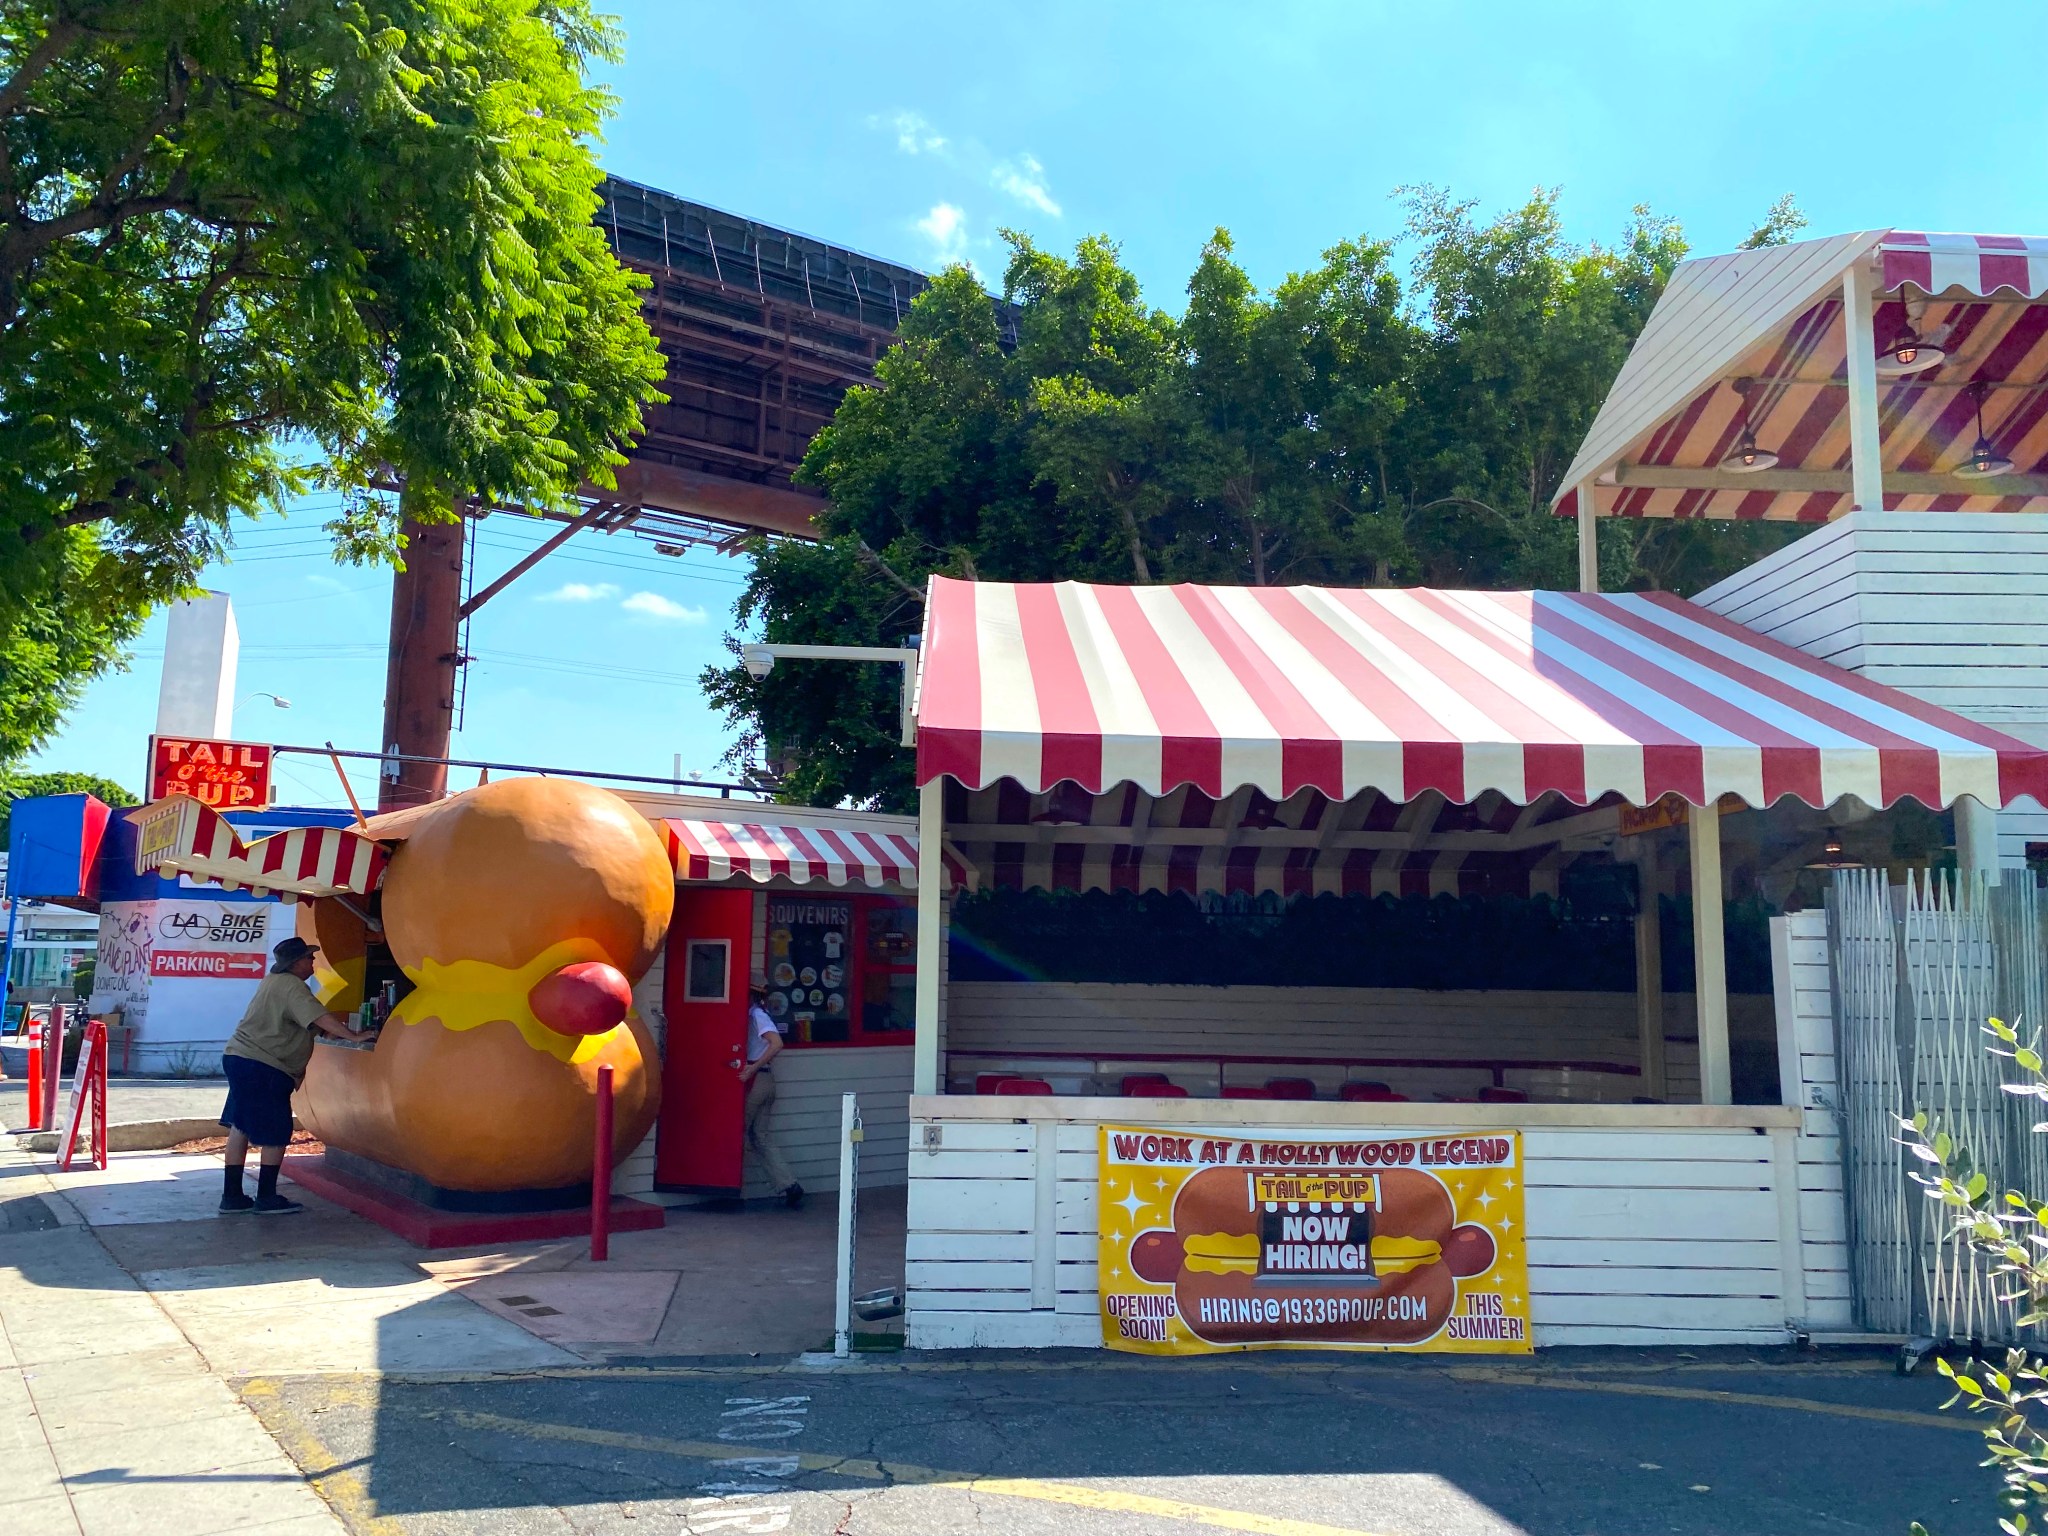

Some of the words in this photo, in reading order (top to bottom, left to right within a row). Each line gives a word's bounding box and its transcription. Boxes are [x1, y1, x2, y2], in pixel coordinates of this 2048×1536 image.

[161, 740, 264, 767] TAIL
[165, 780, 254, 805] PUP
[172, 912, 199, 928] LA
[220, 914, 266, 928] BIKE
[769, 905, 848, 926] SOUVENIRS
[209, 928, 263, 943] SHOP
[155, 955, 225, 972] PARKING
[1114, 1135, 1194, 1162] WORK
[1199, 1141, 1233, 1163] AT
[1237, 1144, 1255, 1164] A
[1260, 1140, 1416, 1166] HOLLYWOOD
[1420, 1138, 1510, 1166] LEGEND
[1261, 1180, 1308, 1199] TAIL
[1324, 1181, 1369, 1199] PUP
[1283, 1216, 1350, 1241] NOW
[1266, 1244, 1366, 1270] HIRING!
[1107, 1295, 1175, 1317] OPENING
[1200, 1296, 1427, 1324] HIRING@1933GROUP.COM
[1466, 1294, 1503, 1316] THIS
[1120, 1318, 1166, 1341] SOON!
[1447, 1316, 1525, 1340] SUMMER!
